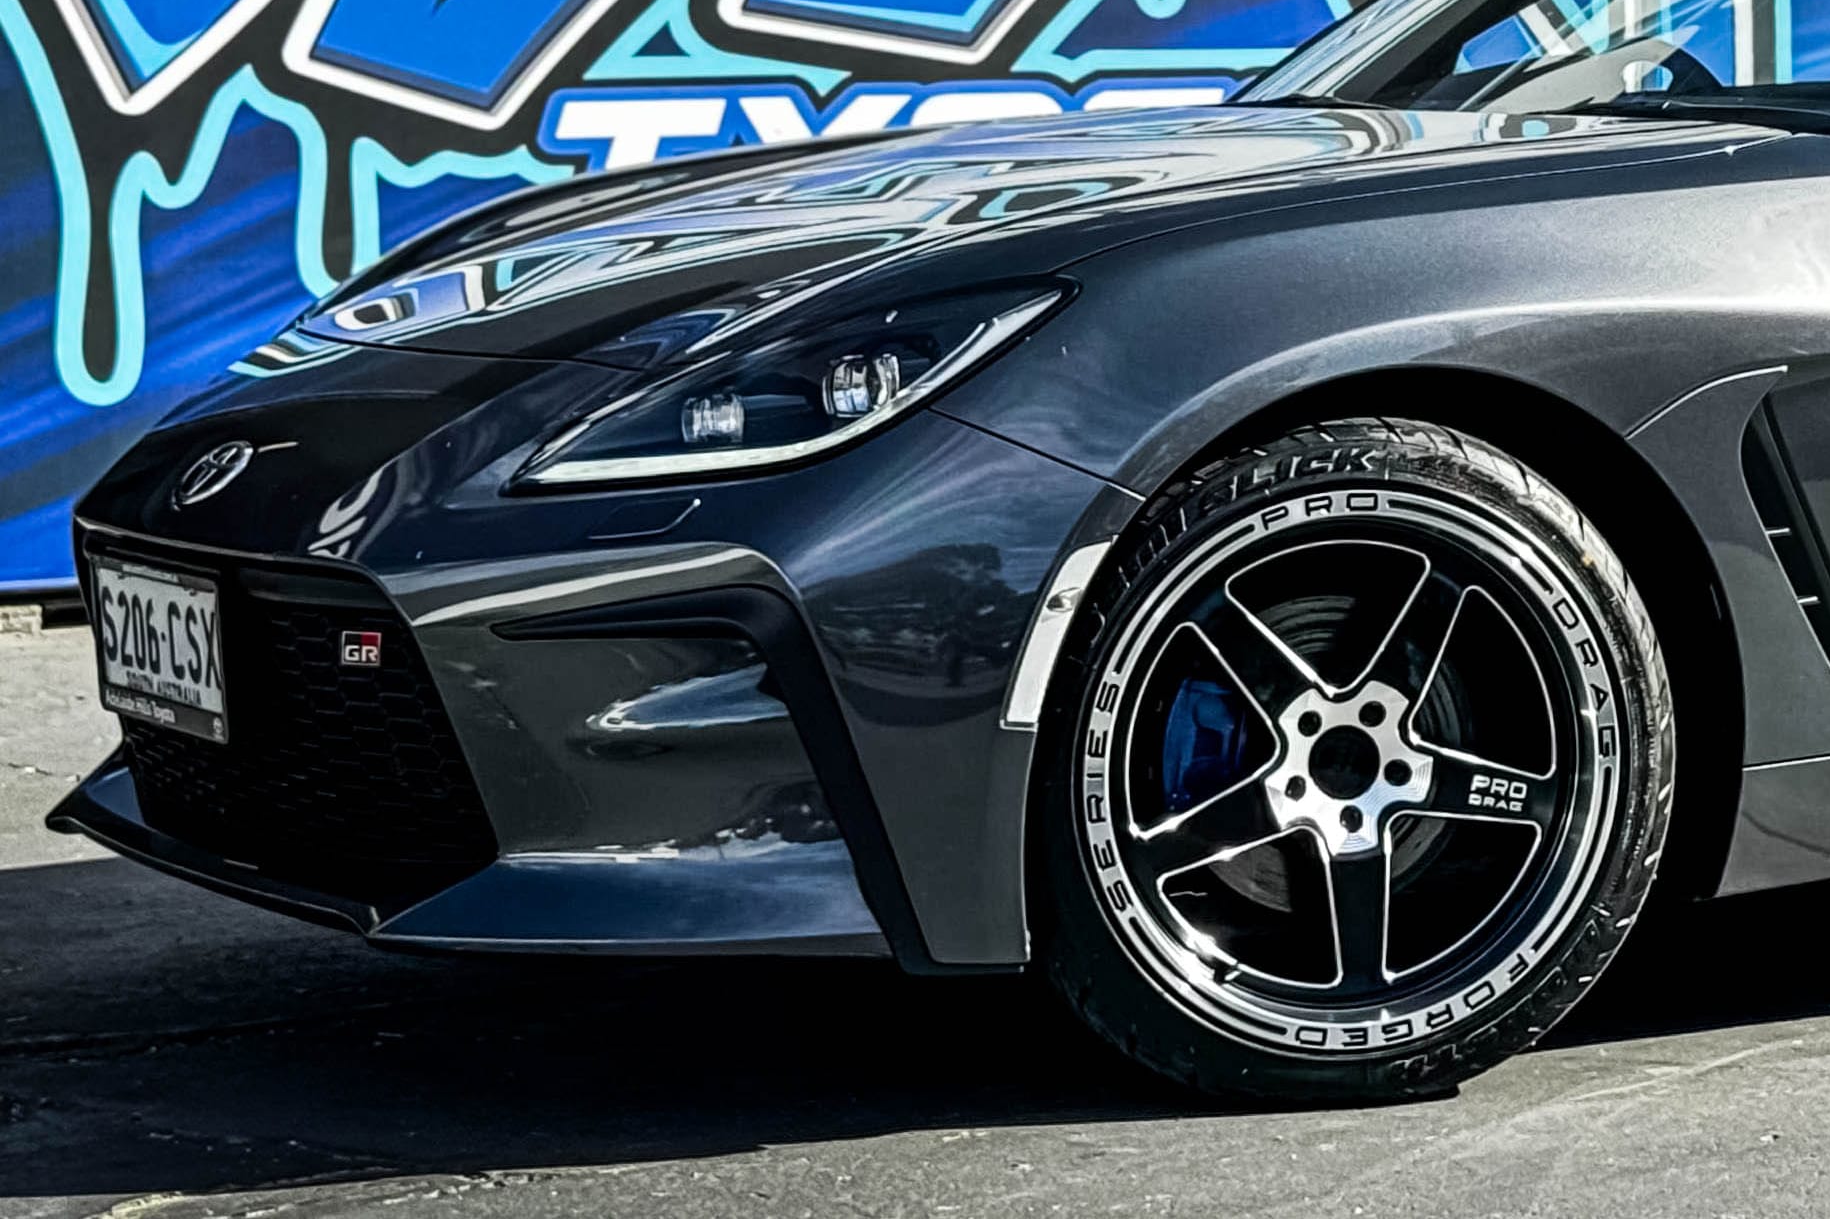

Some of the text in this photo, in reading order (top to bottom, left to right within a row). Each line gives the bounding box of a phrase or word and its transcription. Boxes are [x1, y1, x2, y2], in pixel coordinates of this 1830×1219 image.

[1260, 492, 1379, 530] PRO
[345, 645, 377, 662] GR
[1553, 597, 1616, 758] DRAG
[1086, 681, 1133, 912] SERIES
[1468, 793, 1523, 812] DRAG
[1470, 774, 1527, 799] PRO
[1296, 953, 1529, 1047] FORGED
